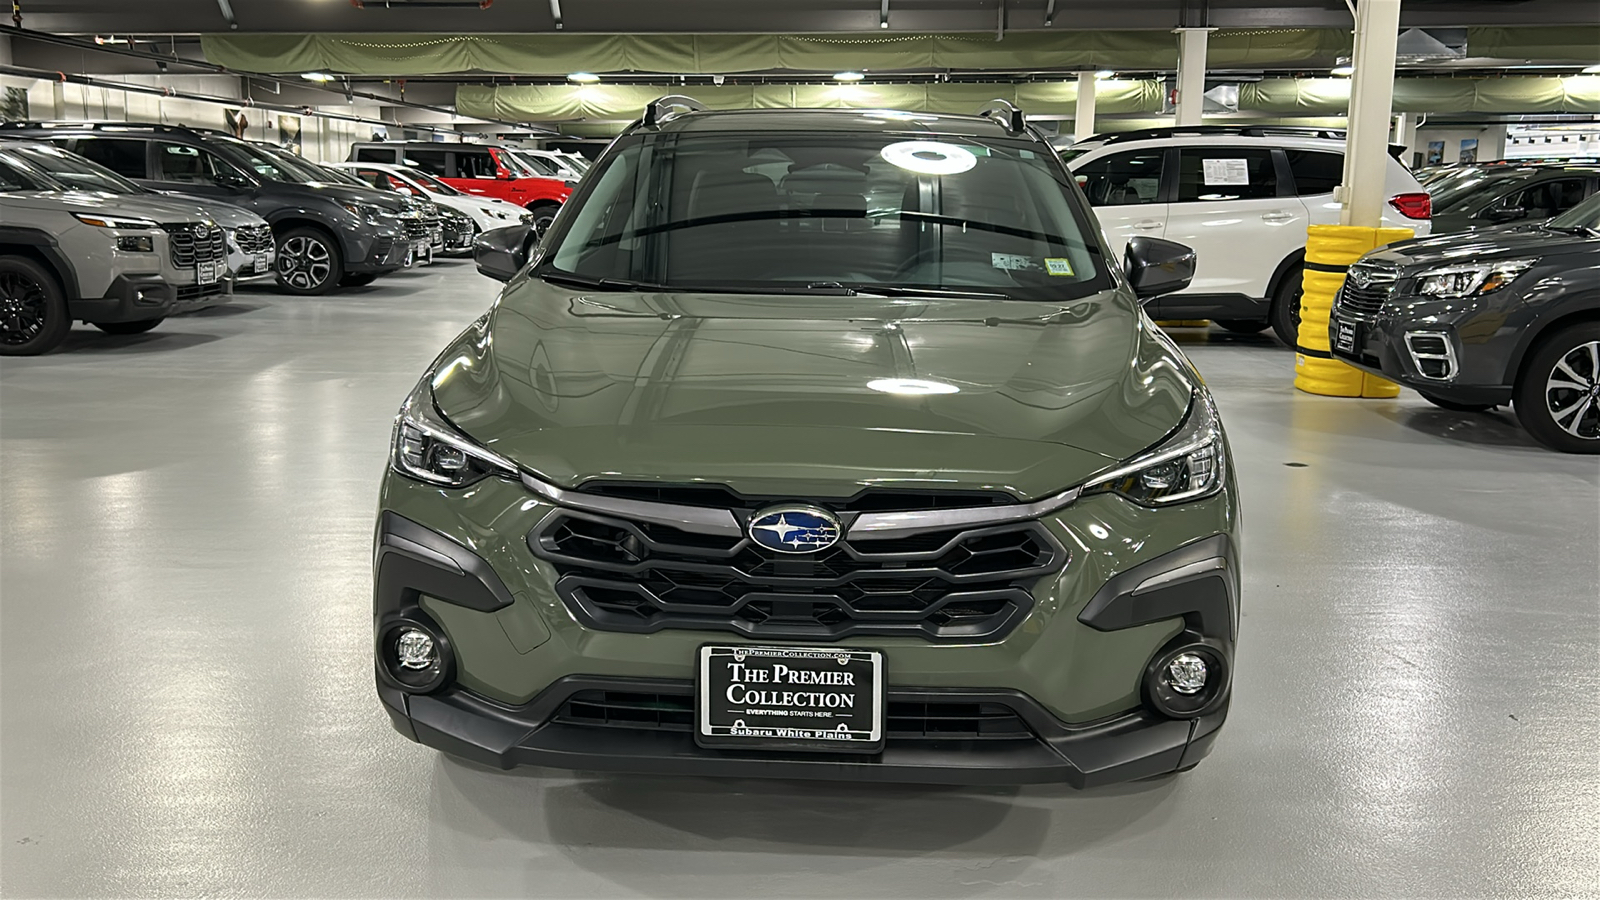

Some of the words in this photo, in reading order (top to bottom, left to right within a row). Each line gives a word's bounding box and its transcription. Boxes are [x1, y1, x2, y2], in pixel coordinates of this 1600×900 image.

[727, 662, 769, 683] THE
[772, 664, 855, 686] PREMIER
[726, 684, 855, 708] COLLECTION
[730, 728, 772, 737] Subaru
[776, 729, 811, 738] White
[815, 731, 852, 740] Plains
